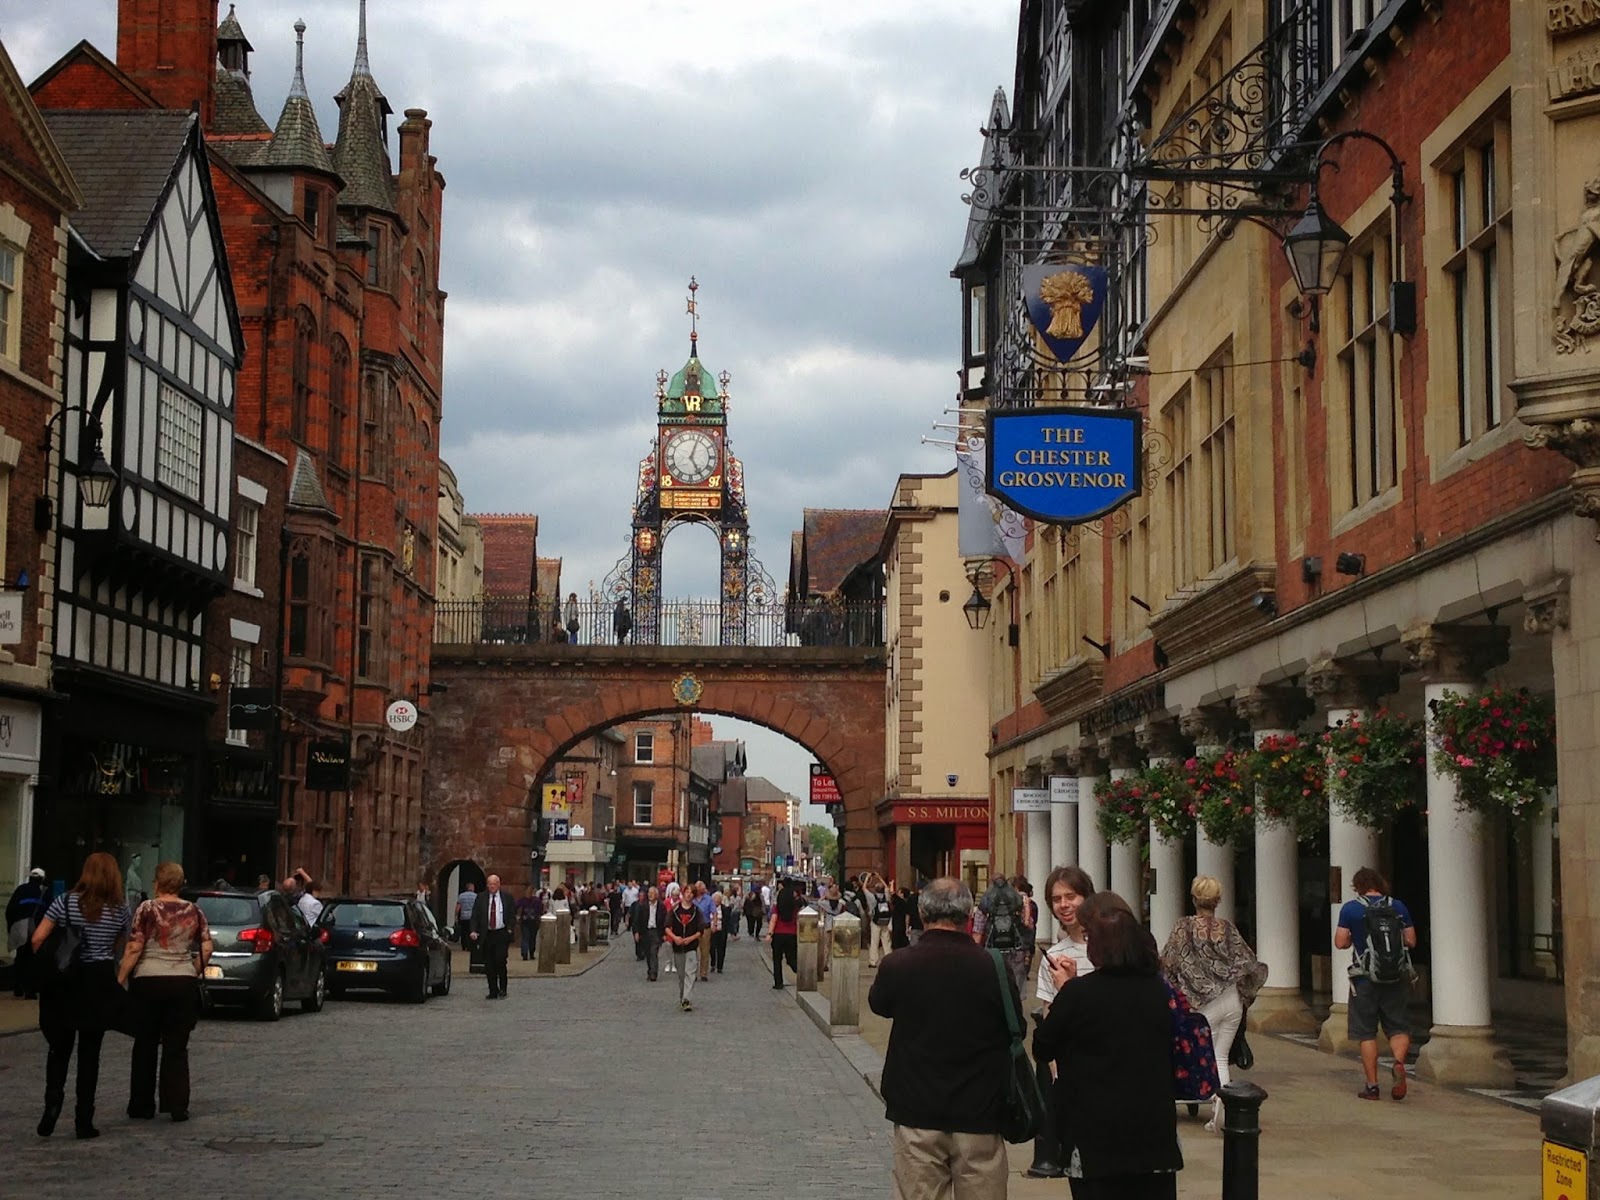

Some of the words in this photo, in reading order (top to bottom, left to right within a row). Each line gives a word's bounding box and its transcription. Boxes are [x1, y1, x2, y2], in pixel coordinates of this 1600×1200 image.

[1041, 428, 1085, 444] THE
[1014, 449, 1111, 466] CHESTER
[661, 475, 673, 486] 18
[708, 475, 721, 487] 97
[999, 471, 1127, 488] GROSVENOR
[389, 715, 415, 723] HSBC
[1546, 1149, 1582, 1173] Restricted
[1555, 1170, 1573, 1188] Zone
